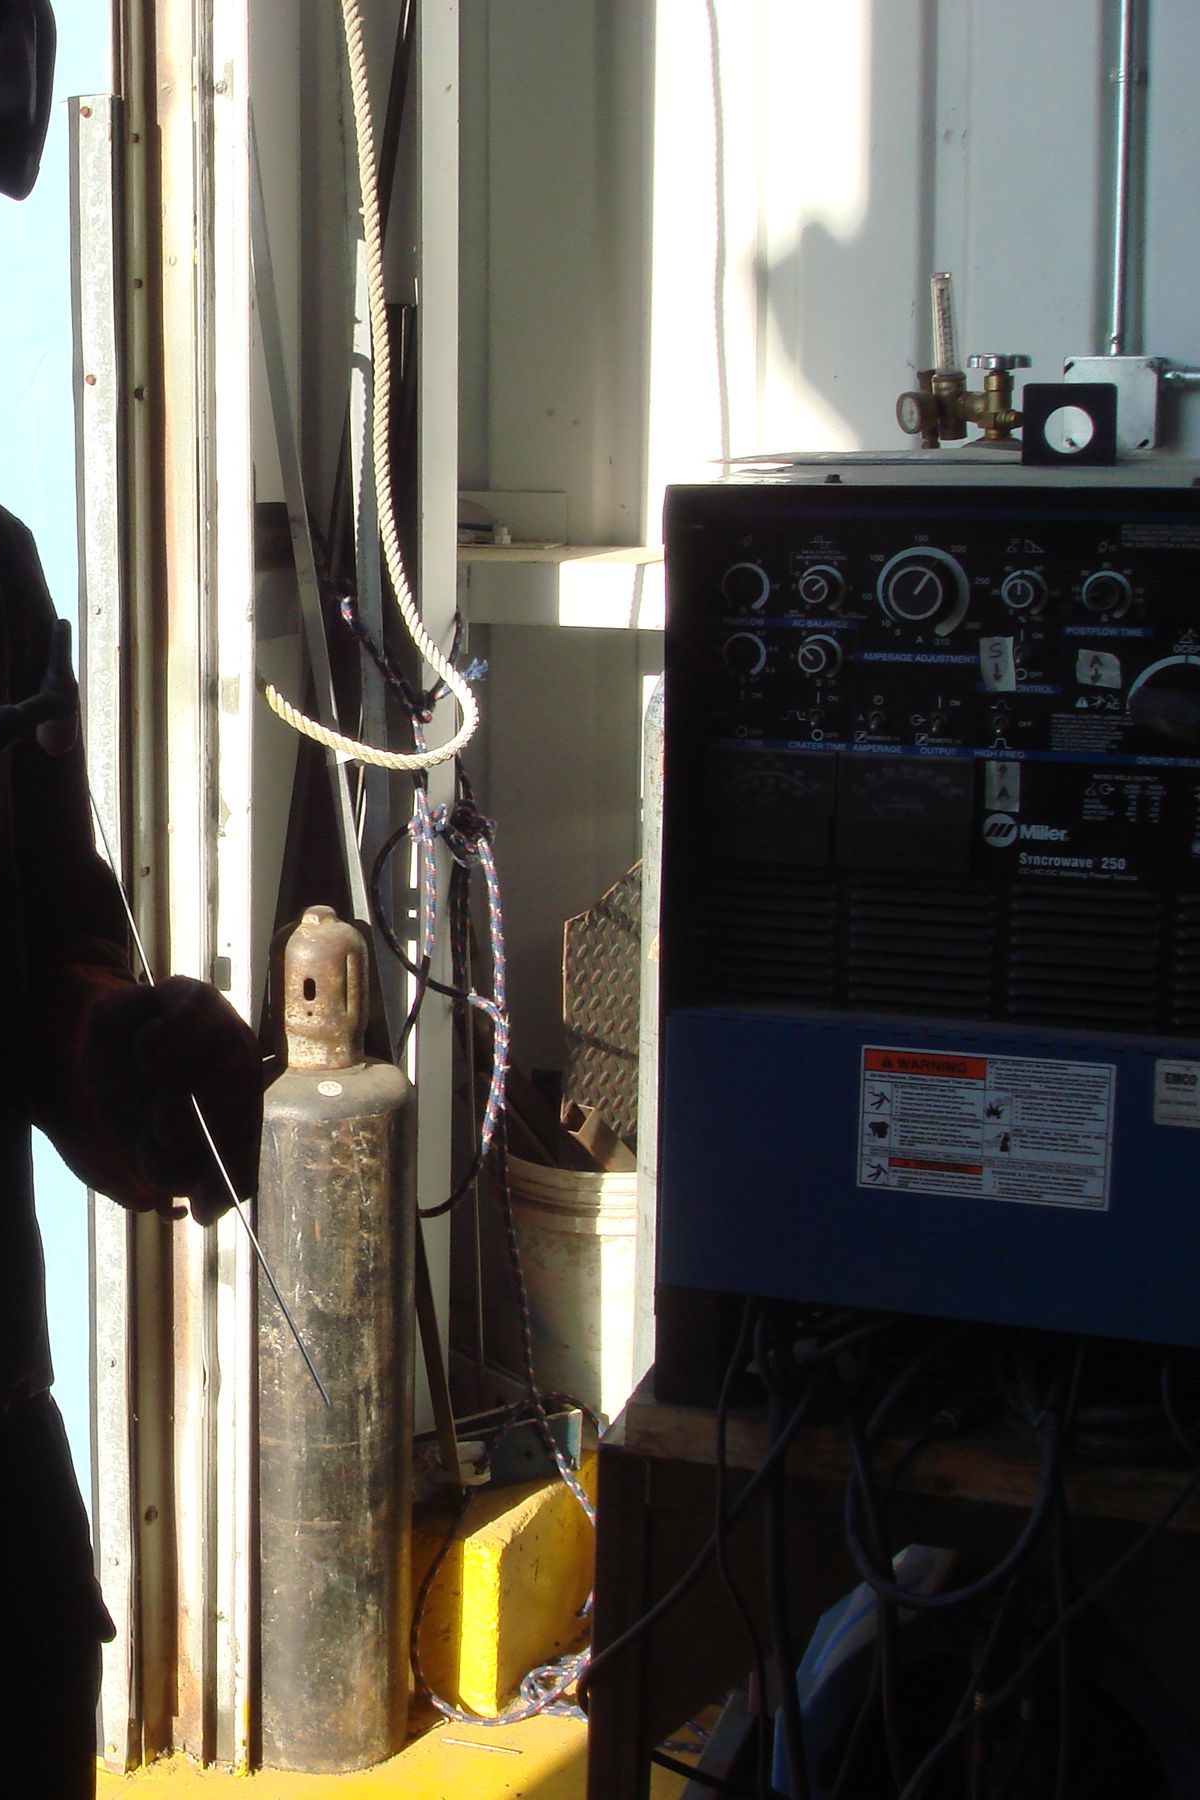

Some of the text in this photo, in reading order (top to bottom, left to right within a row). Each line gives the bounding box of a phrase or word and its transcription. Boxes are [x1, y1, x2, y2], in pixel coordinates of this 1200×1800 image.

[870, 554, 885, 562] 100
[974, 577, 990, 585] 250
[807, 620, 848, 628] BALANCE
[863, 652, 977, 663] AMPERAGE ADJUSTMENT
[788, 740, 820, 750] CRATER
[852, 744, 903, 754] AMPERAGE
[919, 747, 957, 756] OUTPUT
[974, 749, 999, 758] HIGH
[1136, 756, 1175, 765] OUTPUT
[1020, 823, 1068, 841] Miller
[1019, 852, 1126, 870] Syncrowave 250
[897, 1058, 968, 1074] WARNING
